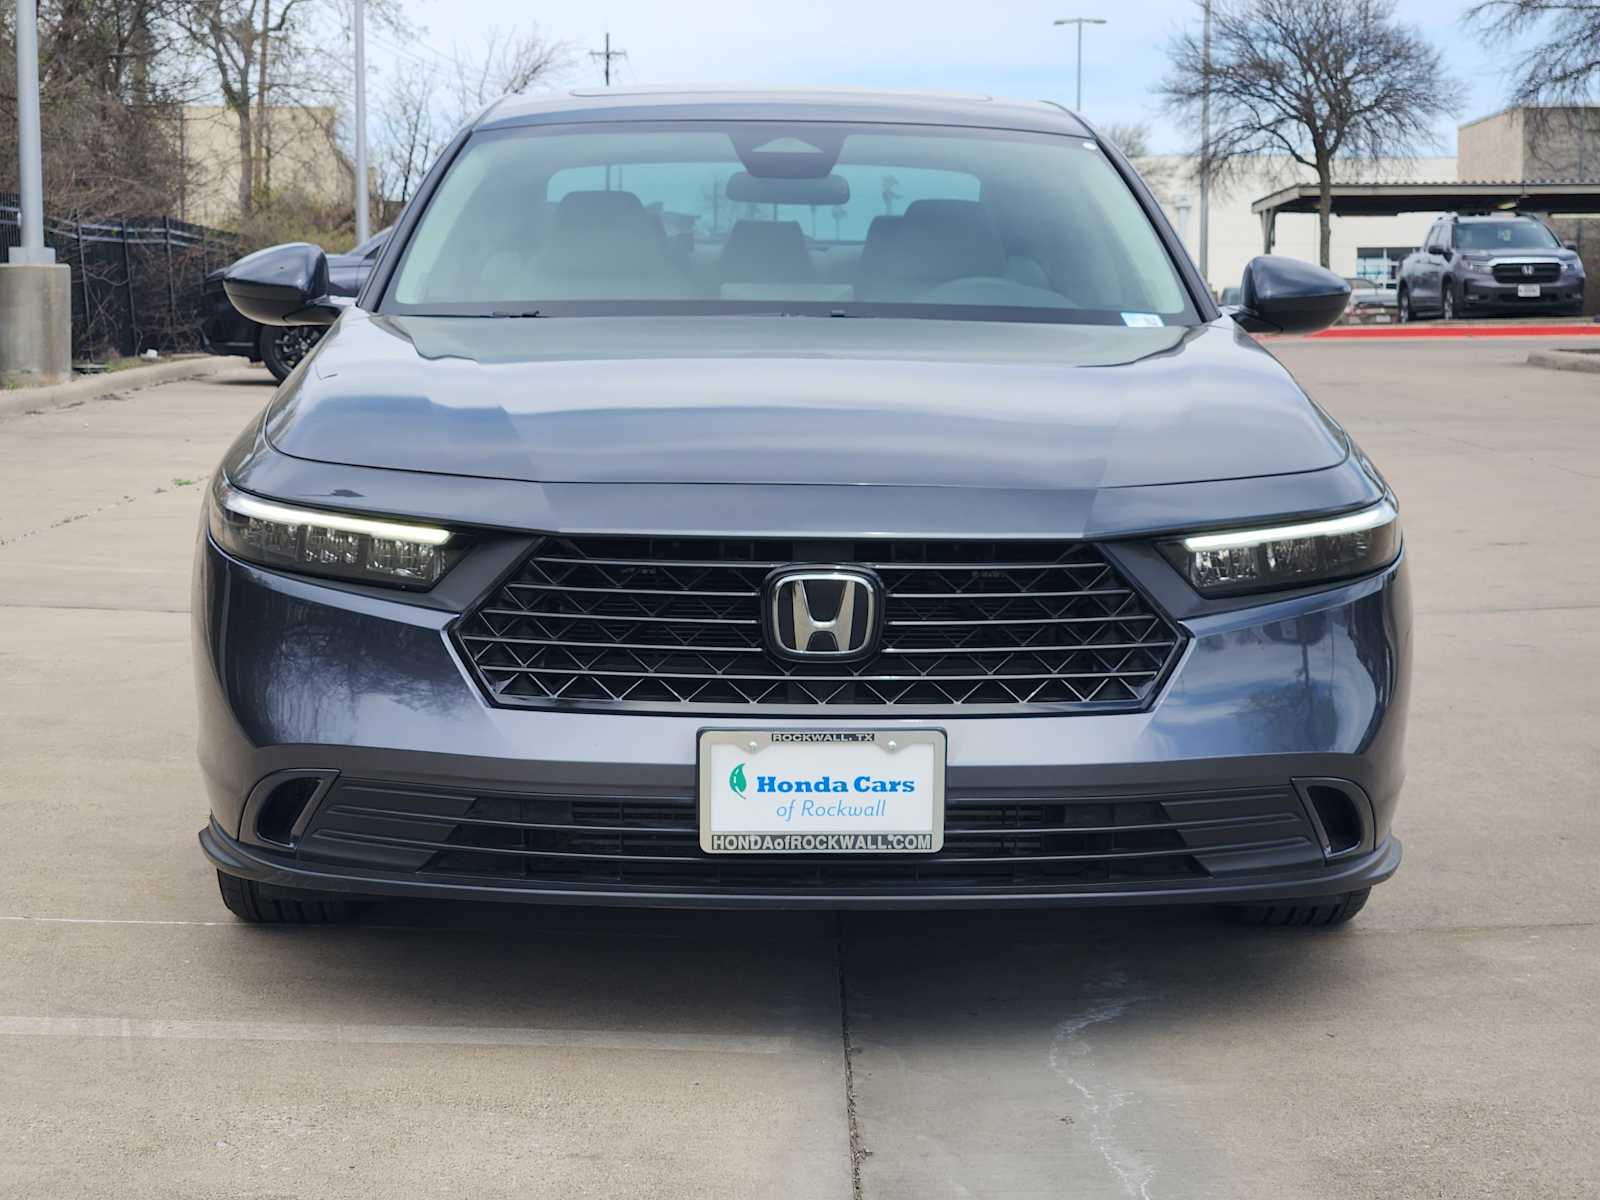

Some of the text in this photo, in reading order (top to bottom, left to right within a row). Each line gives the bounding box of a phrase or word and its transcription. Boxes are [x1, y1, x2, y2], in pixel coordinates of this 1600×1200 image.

[856, 733, 874, 742] TX
[756, 775, 915, 793] Honda Cars
[776, 799, 887, 822] of Rockwall
[712, 834, 932, 850] HONDAofROCKWALL.COM
